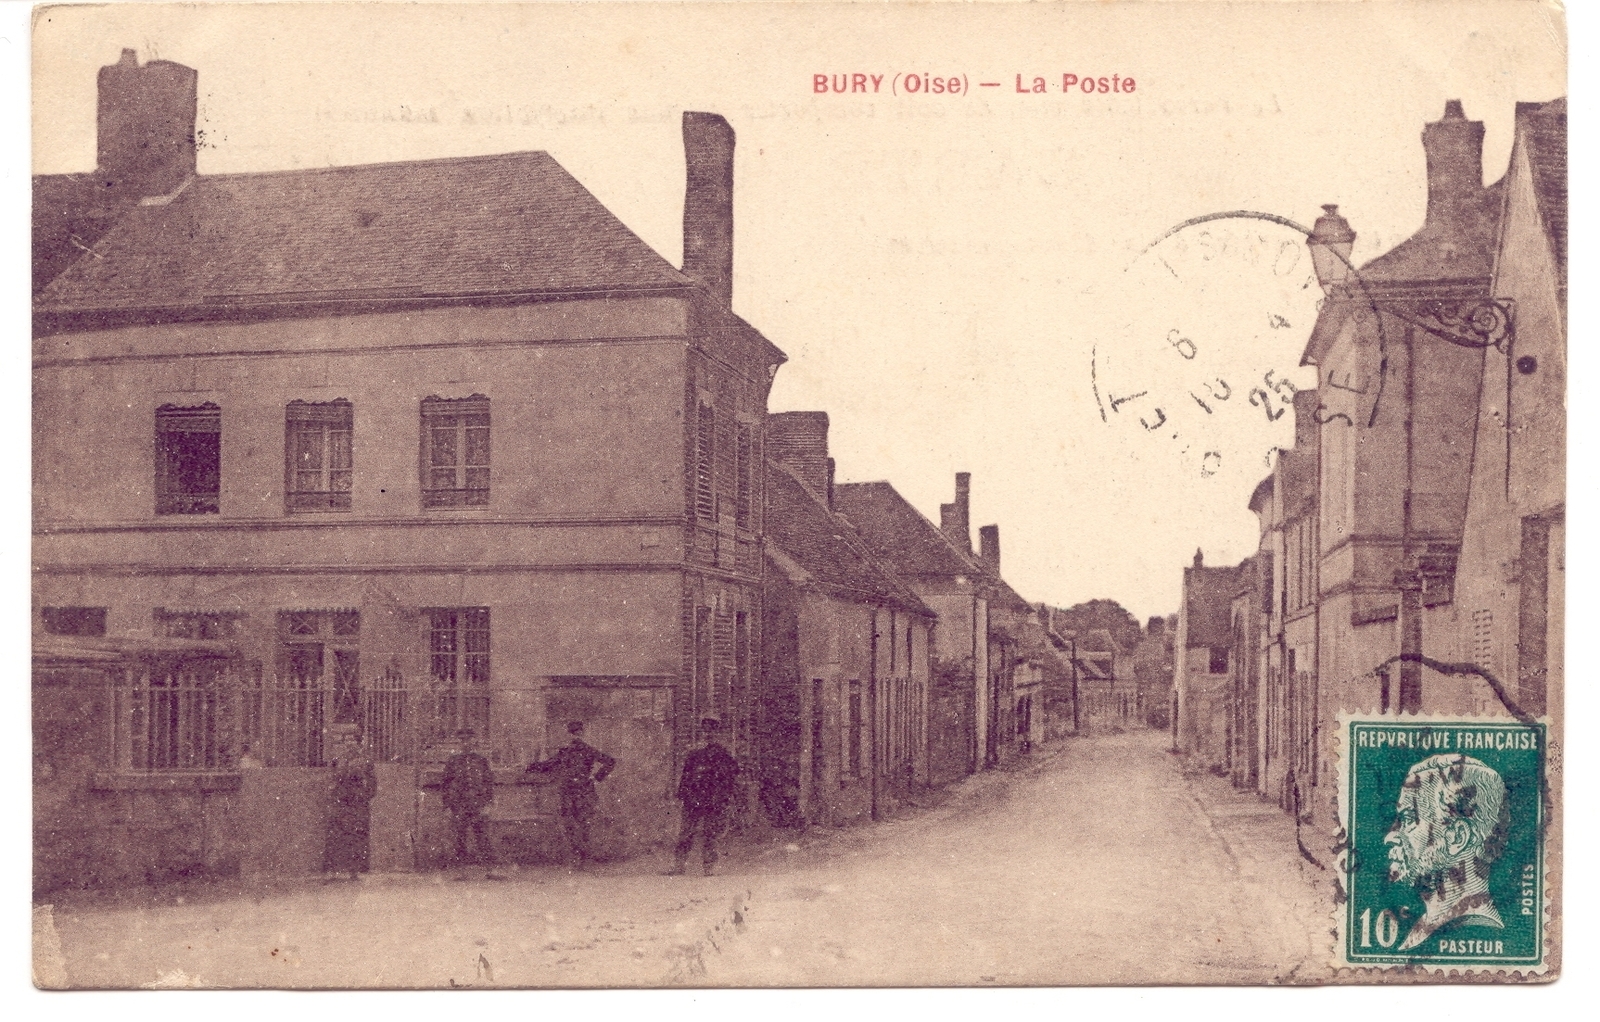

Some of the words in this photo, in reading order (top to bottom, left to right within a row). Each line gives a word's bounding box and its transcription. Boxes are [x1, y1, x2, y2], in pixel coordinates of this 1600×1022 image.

[1456, 732, 1538, 752] FRANÇAISE
[1521, 863, 1535, 916] POSTES
[1438, 939, 1504, 956] PASTEUR
